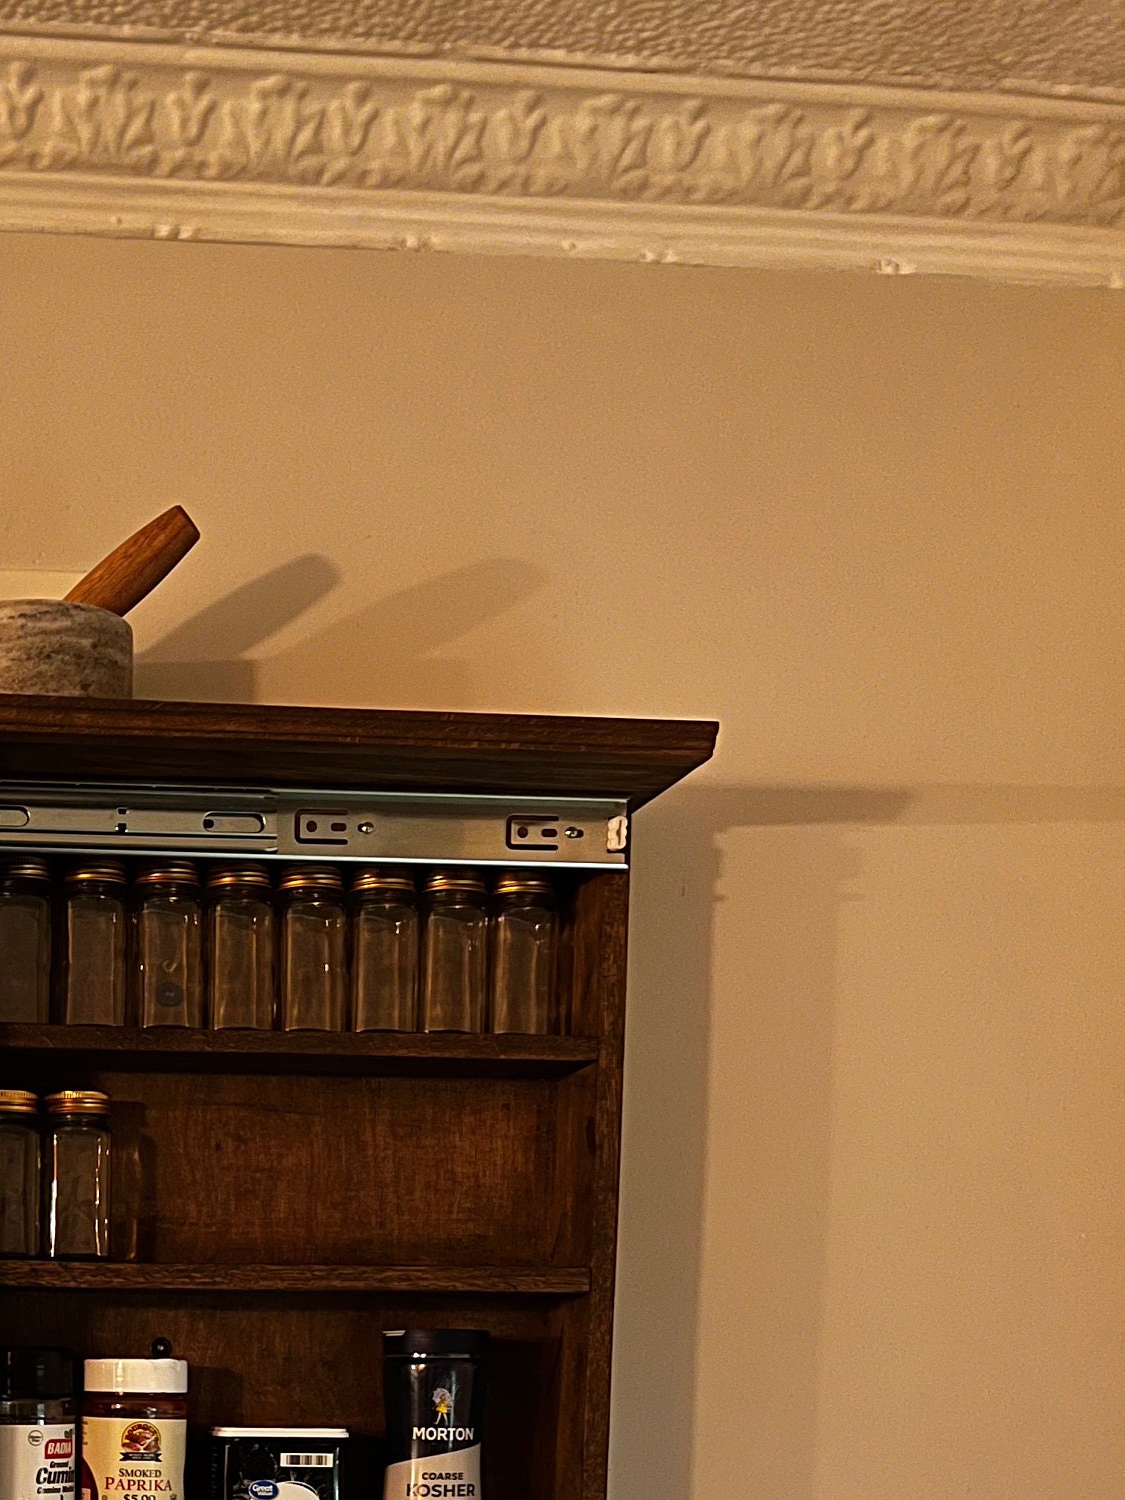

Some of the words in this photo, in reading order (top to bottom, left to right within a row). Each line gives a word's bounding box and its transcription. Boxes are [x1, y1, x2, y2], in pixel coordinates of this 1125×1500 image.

[412, 1426, 475, 1441] MORTON
[47, 1441, 72, 1455] BADIA
[118, 1467, 162, 1478] SMOKED
[421, 1472, 464, 1481] COARSE
[104, 1476, 173, 1491] PAPRIKA
[406, 1483, 475, 1498] KOSHER
